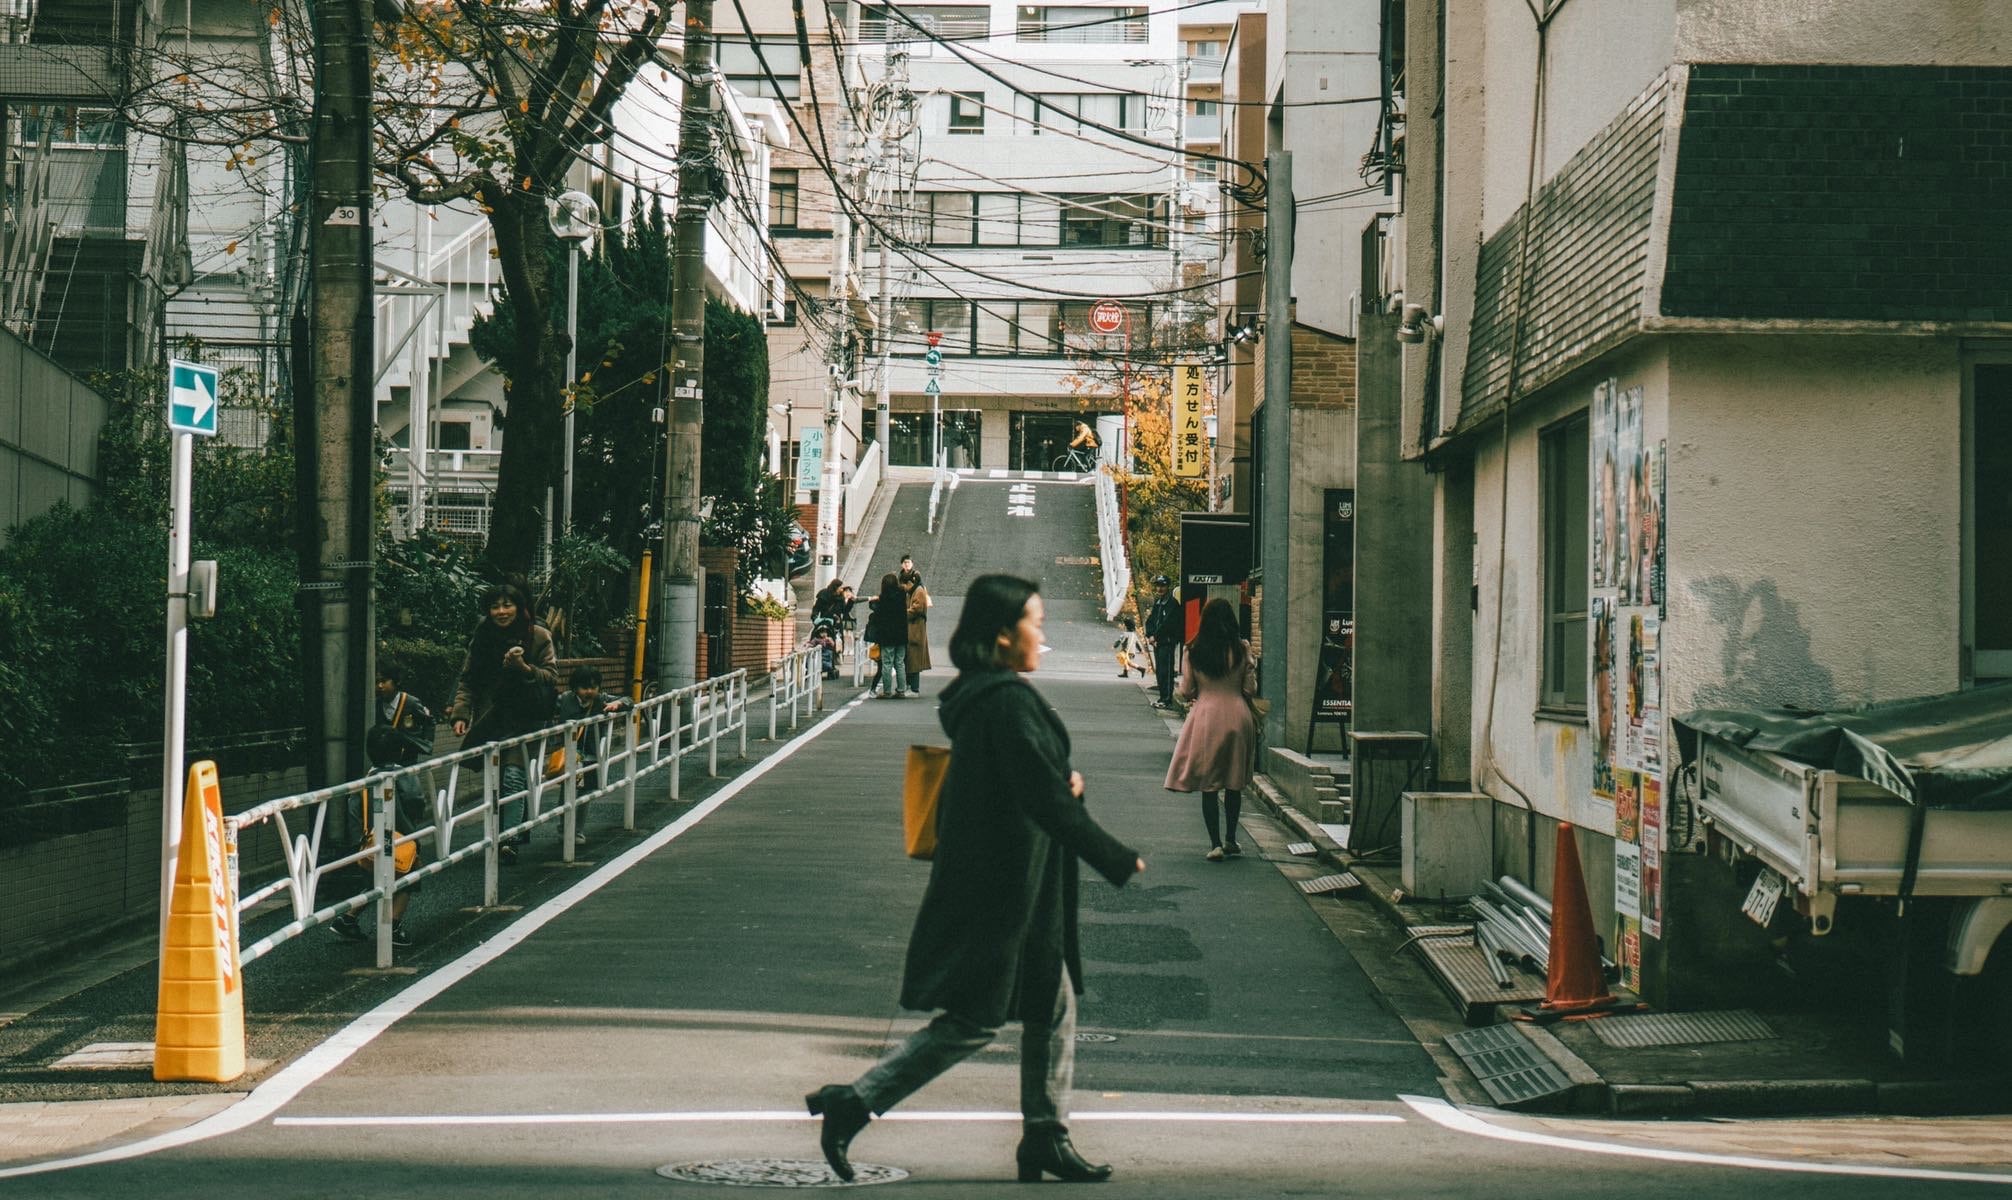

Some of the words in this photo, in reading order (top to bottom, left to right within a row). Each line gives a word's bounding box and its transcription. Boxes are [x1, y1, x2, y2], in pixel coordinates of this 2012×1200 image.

[339, 210, 354, 219] 30
[1185, 366, 1199, 463] 処方せん受付
